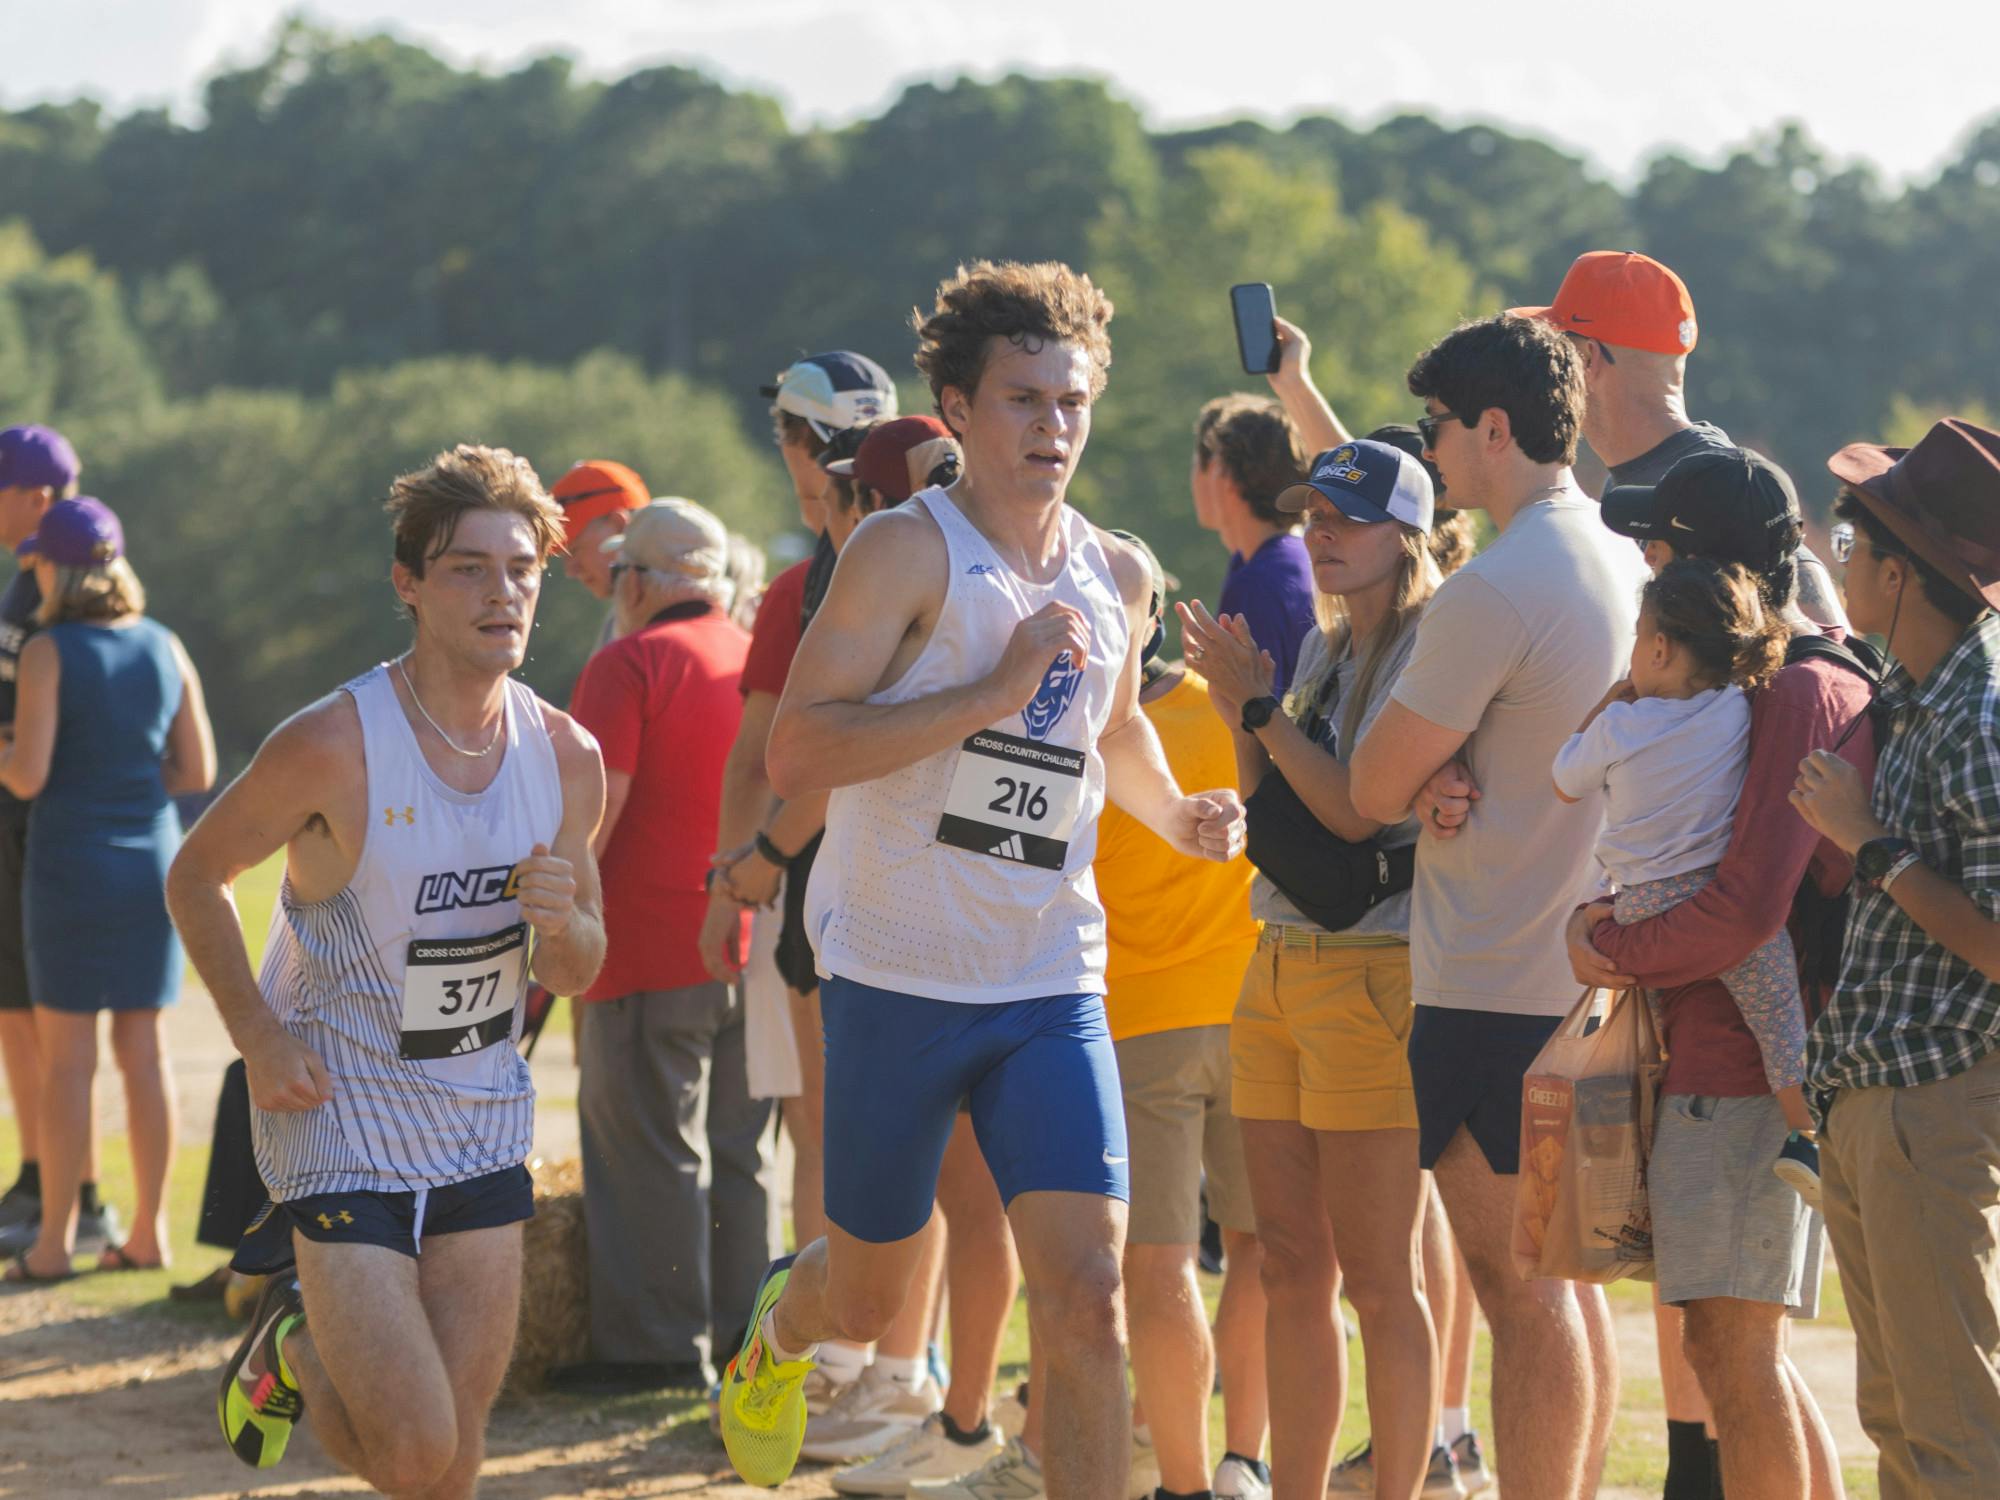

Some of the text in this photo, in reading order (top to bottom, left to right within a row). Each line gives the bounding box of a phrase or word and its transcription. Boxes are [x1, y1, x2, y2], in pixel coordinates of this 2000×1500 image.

[973, 736, 1081, 770] CROSS COUNTRY CHALLENGE
[988, 777, 1048, 822] 216
[415, 947, 449, 958] CROSS
[448, 944, 488, 957] COUNTRY
[438, 969, 501, 1016] 377
